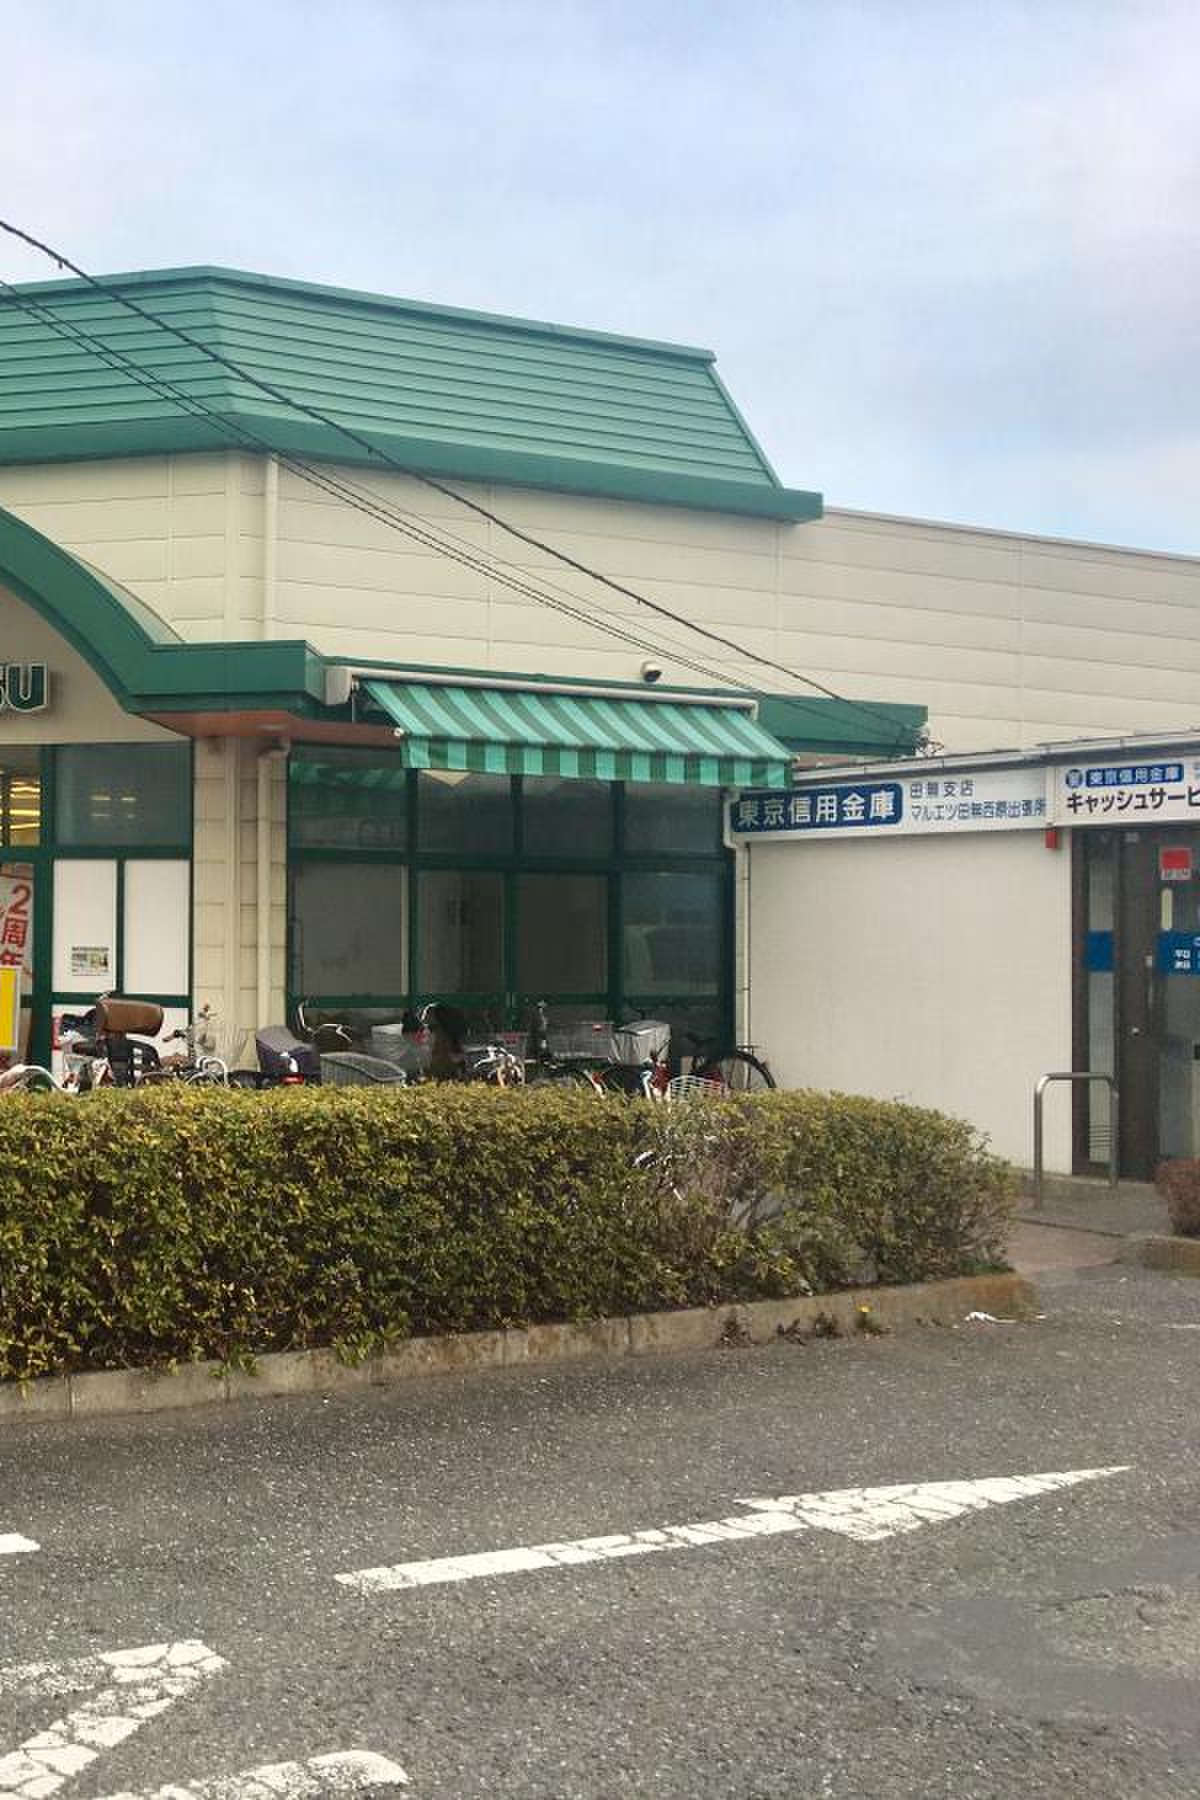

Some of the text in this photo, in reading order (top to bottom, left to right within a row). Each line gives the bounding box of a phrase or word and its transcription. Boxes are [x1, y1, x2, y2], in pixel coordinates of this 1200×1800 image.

[737, 790, 896, 829] 東京信用金庫
